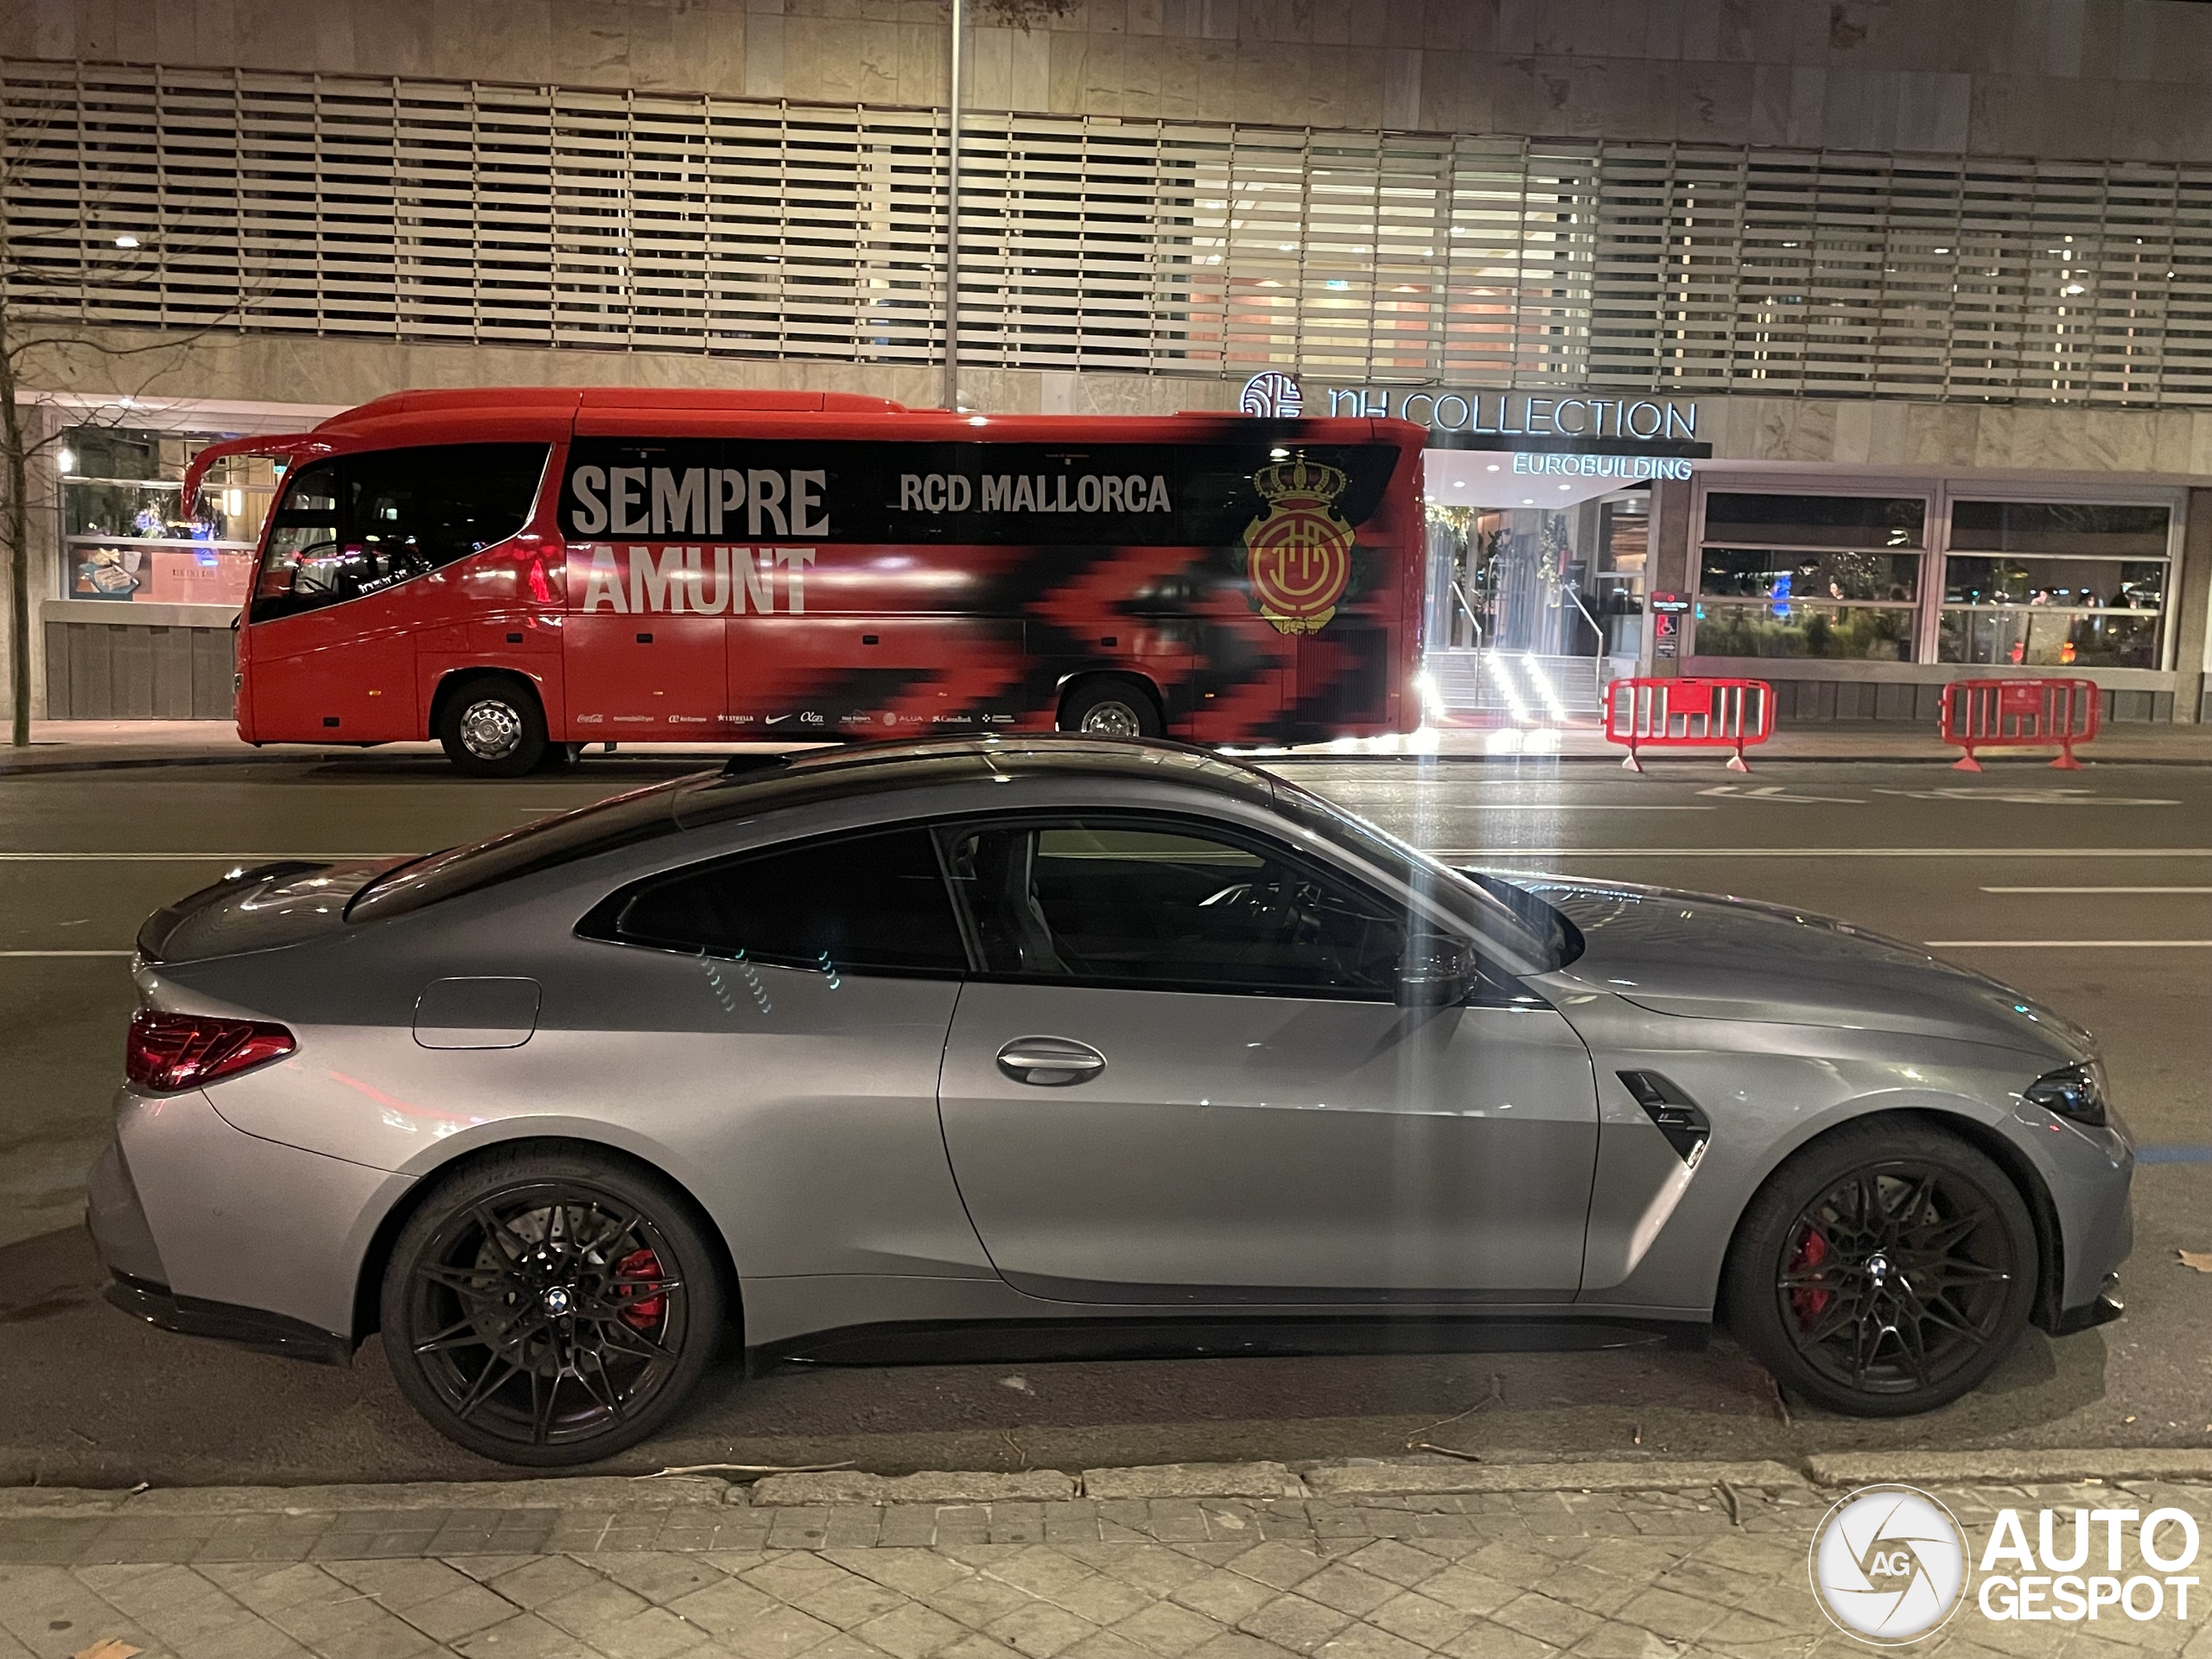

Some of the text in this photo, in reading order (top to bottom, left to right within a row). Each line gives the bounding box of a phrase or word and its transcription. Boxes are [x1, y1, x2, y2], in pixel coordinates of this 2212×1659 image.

[1401, 392, 1697, 440] COLLECTION
[1512, 452, 1693, 480] EUROBUILDING
[572, 465, 830, 536] SEMPRE
[900, 474, 1172, 512] RCD MALLORCA
[582, 546, 816, 615] AMUNT
